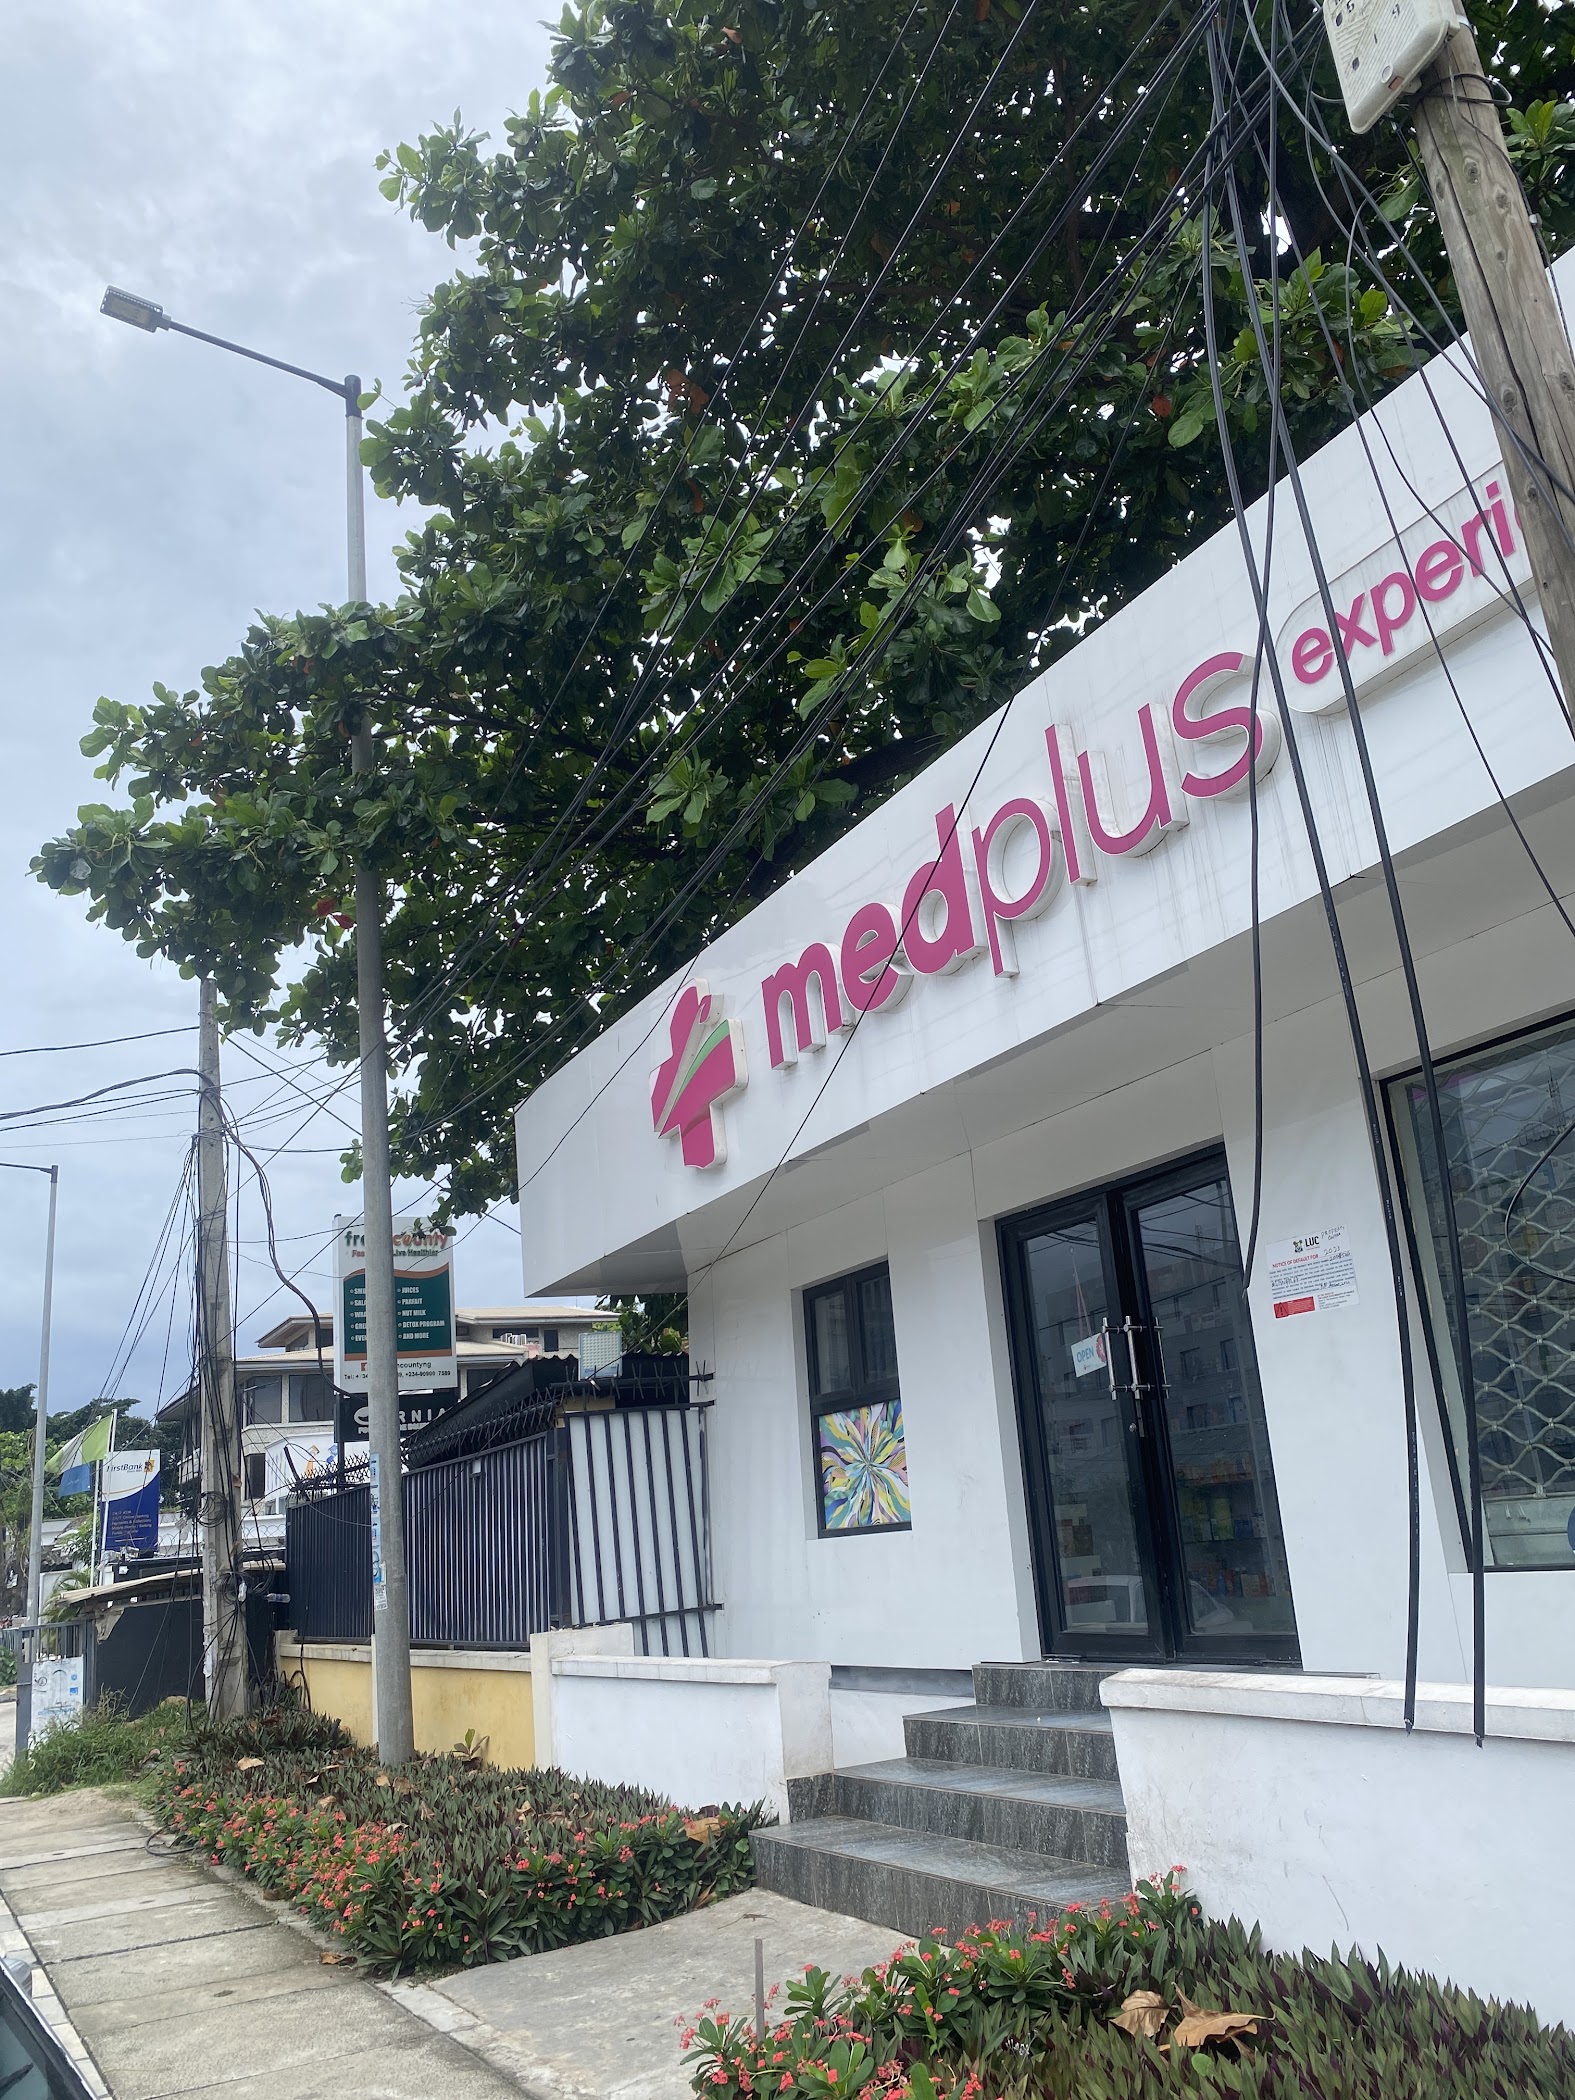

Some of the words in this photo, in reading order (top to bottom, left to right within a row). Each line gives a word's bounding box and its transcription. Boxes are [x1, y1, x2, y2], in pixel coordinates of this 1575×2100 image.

[1292, 480, 1522, 684] experi
[761, 651, 1275, 1069] medplus
[1305, 1236, 1319, 1247] LUC
[1077, 1346, 1095, 1362] OPEN
